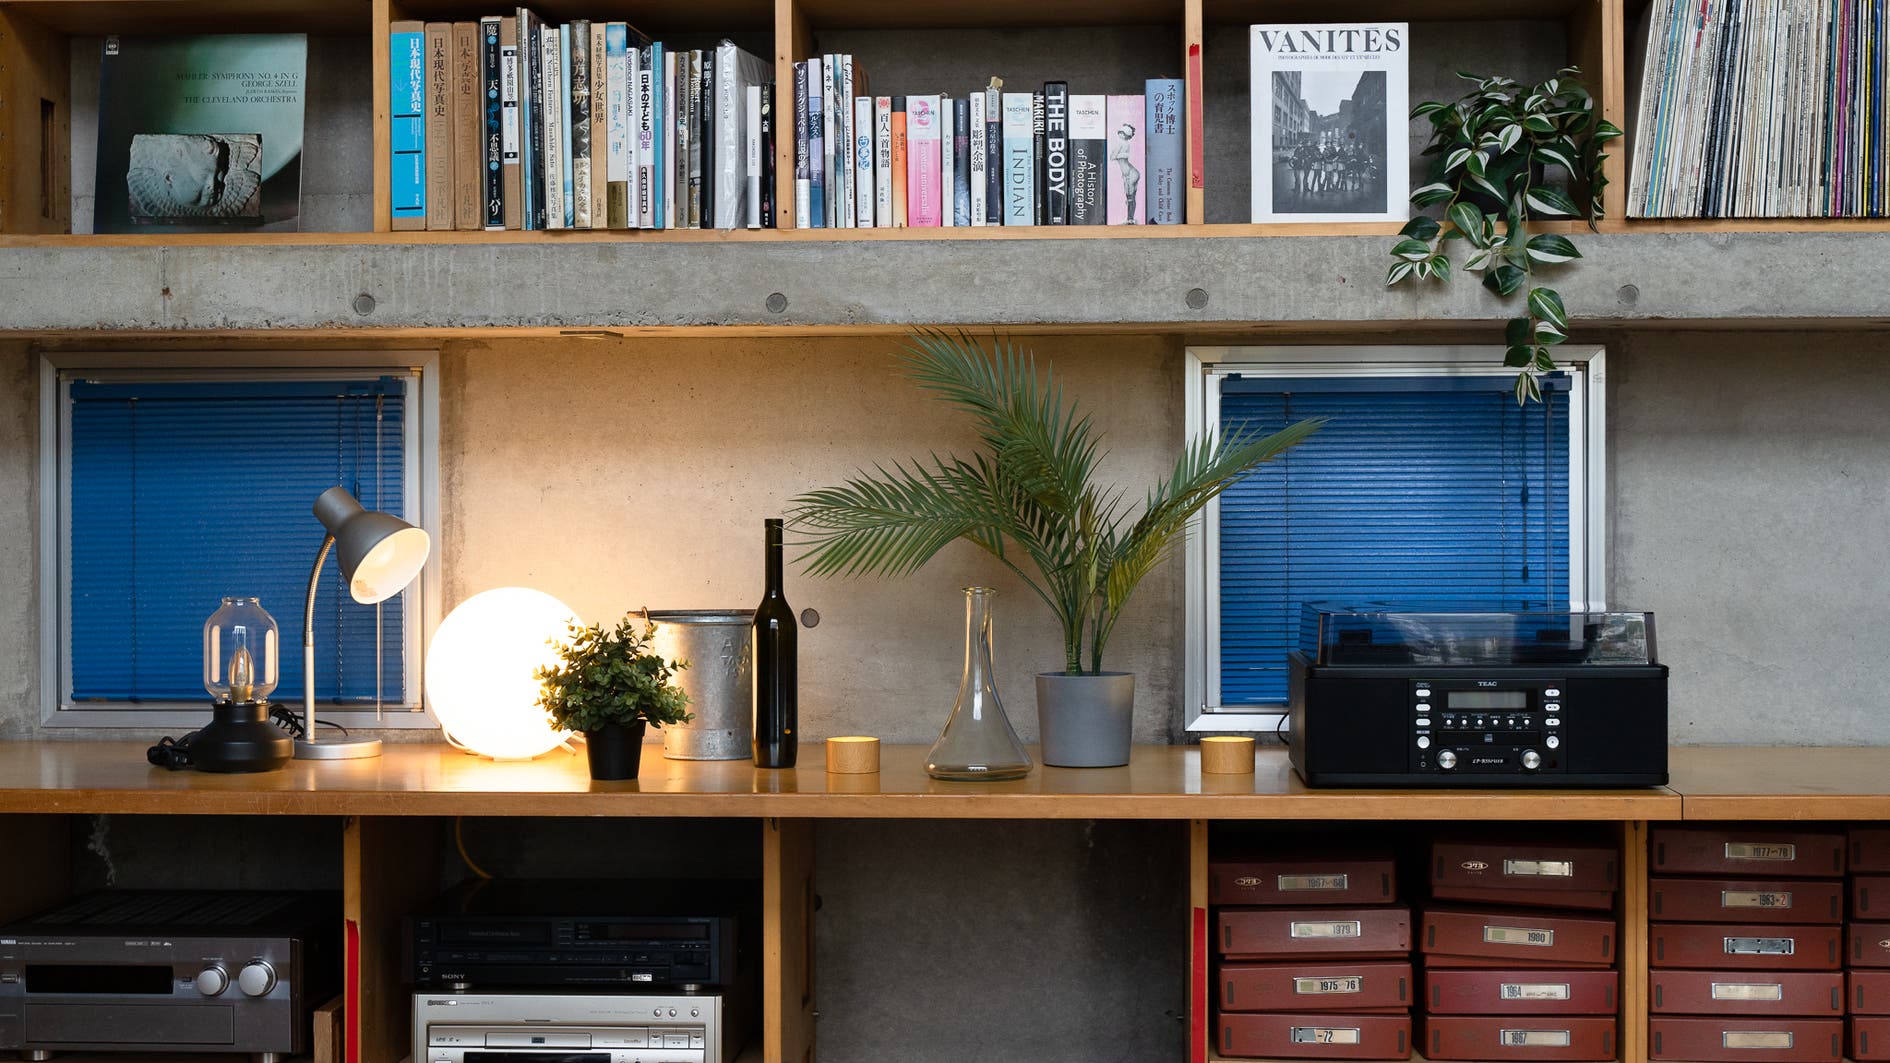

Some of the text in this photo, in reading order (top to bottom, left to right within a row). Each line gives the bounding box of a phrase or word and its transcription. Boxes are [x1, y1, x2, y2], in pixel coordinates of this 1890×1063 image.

[211, 72, 255, 80] SYMPHONY
[409, 37, 422, 113] 日本現代写真史
[432, 37, 446, 118] 日本現代写真史
[459, 35, 472, 96] 日本写真史
[640, 73, 652, 151] 日本の子ども60年
[879, 113, 890, 168] 百人一首物語
[1153, 92, 1165, 134] の育児書
[1047, 90, 1066, 196] THE BODY
[1012, 148, 1028, 218] INDIAN
[1075, 148, 1088, 220] of Photography
[1085, 162, 1097, 207] A History
[1332, 925, 1351, 935] 1979
[1320, 981, 1338, 991] 1975
